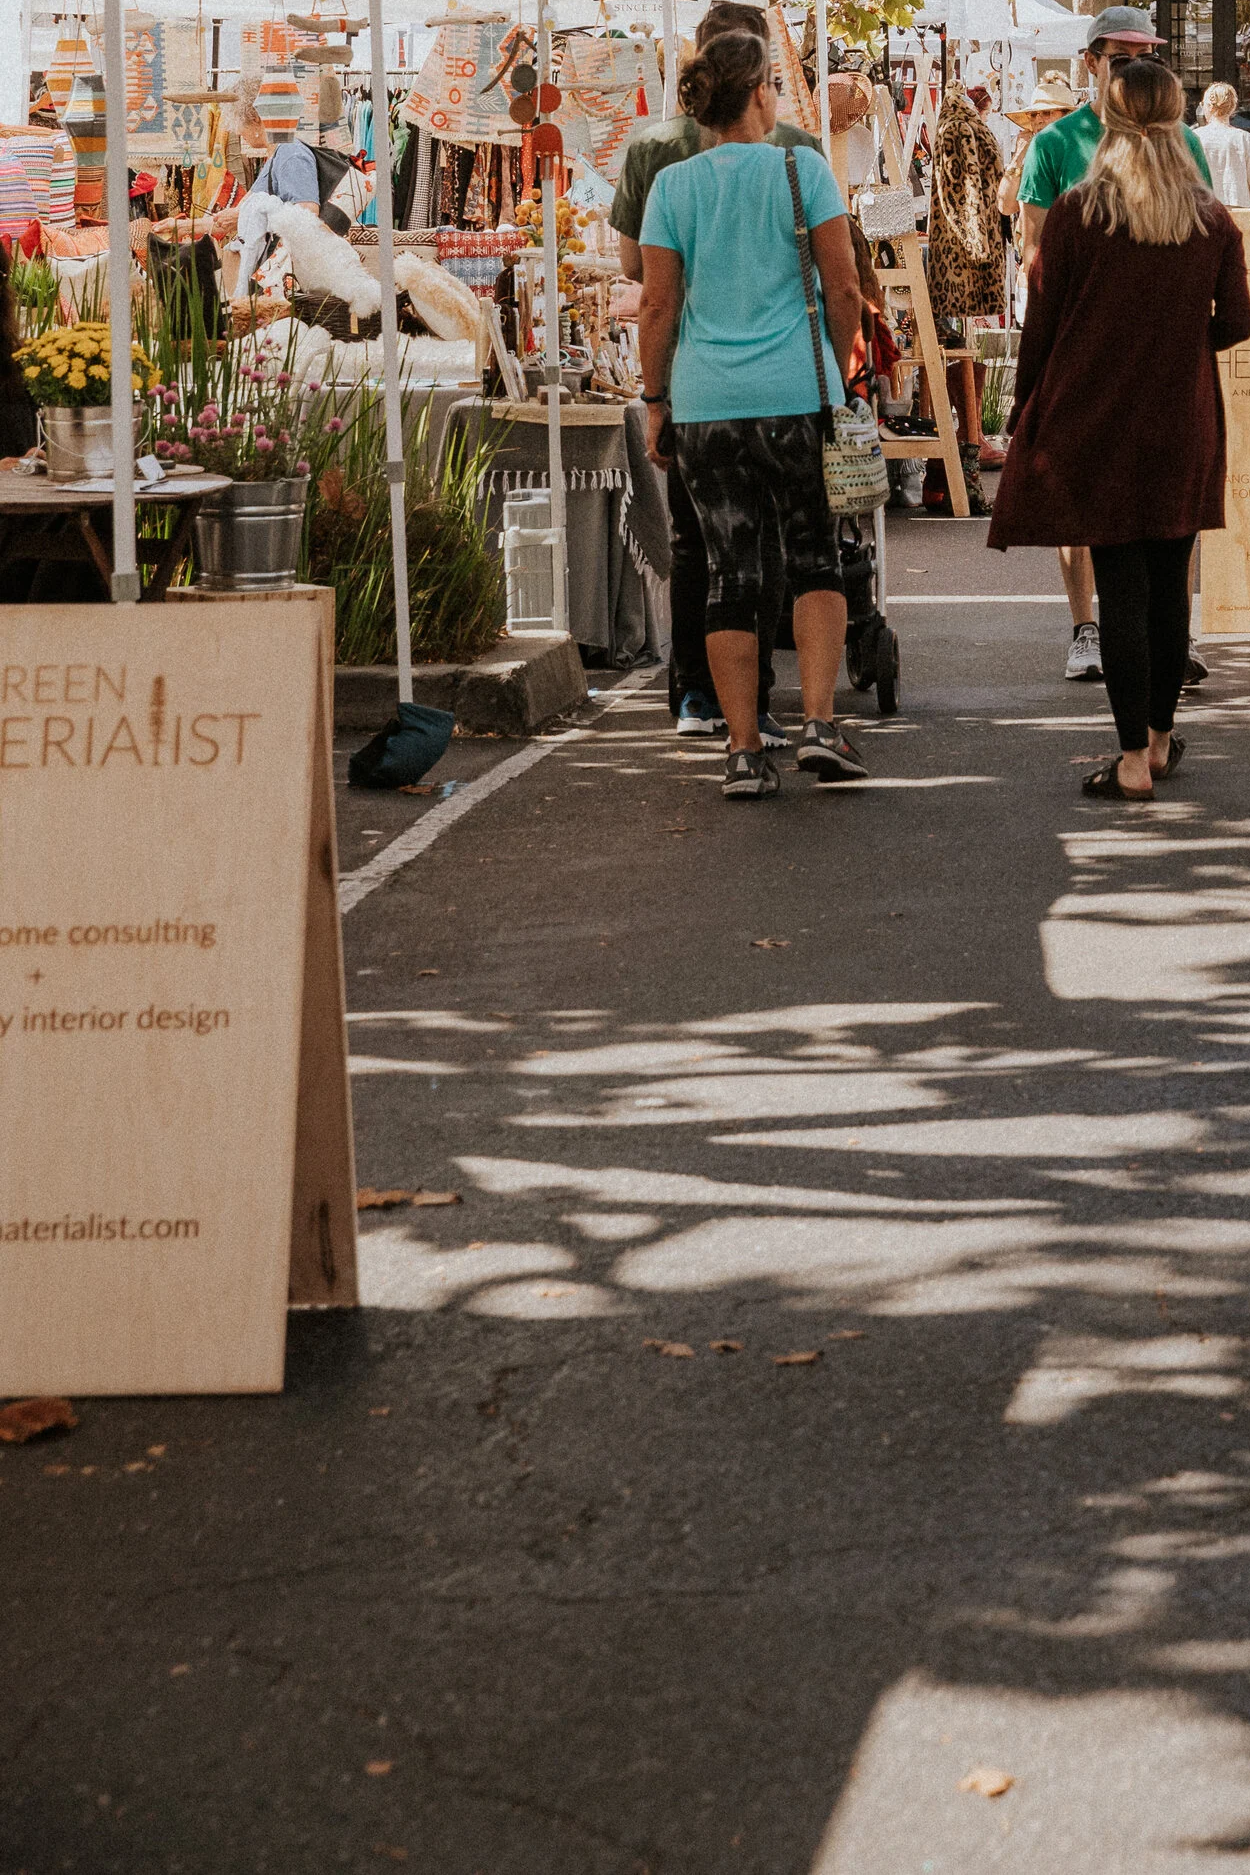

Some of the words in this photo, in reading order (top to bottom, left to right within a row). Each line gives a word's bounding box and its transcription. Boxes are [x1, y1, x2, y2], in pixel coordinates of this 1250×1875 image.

[614, 4, 649, 13] SINCE
[1232, 389, 1240, 397] A
[67, 916, 217, 950] consulting
[22, 1005, 130, 1033] interior
[136, 1002, 230, 1036] design
[0, 1213, 200, 1243] aterialist.com
